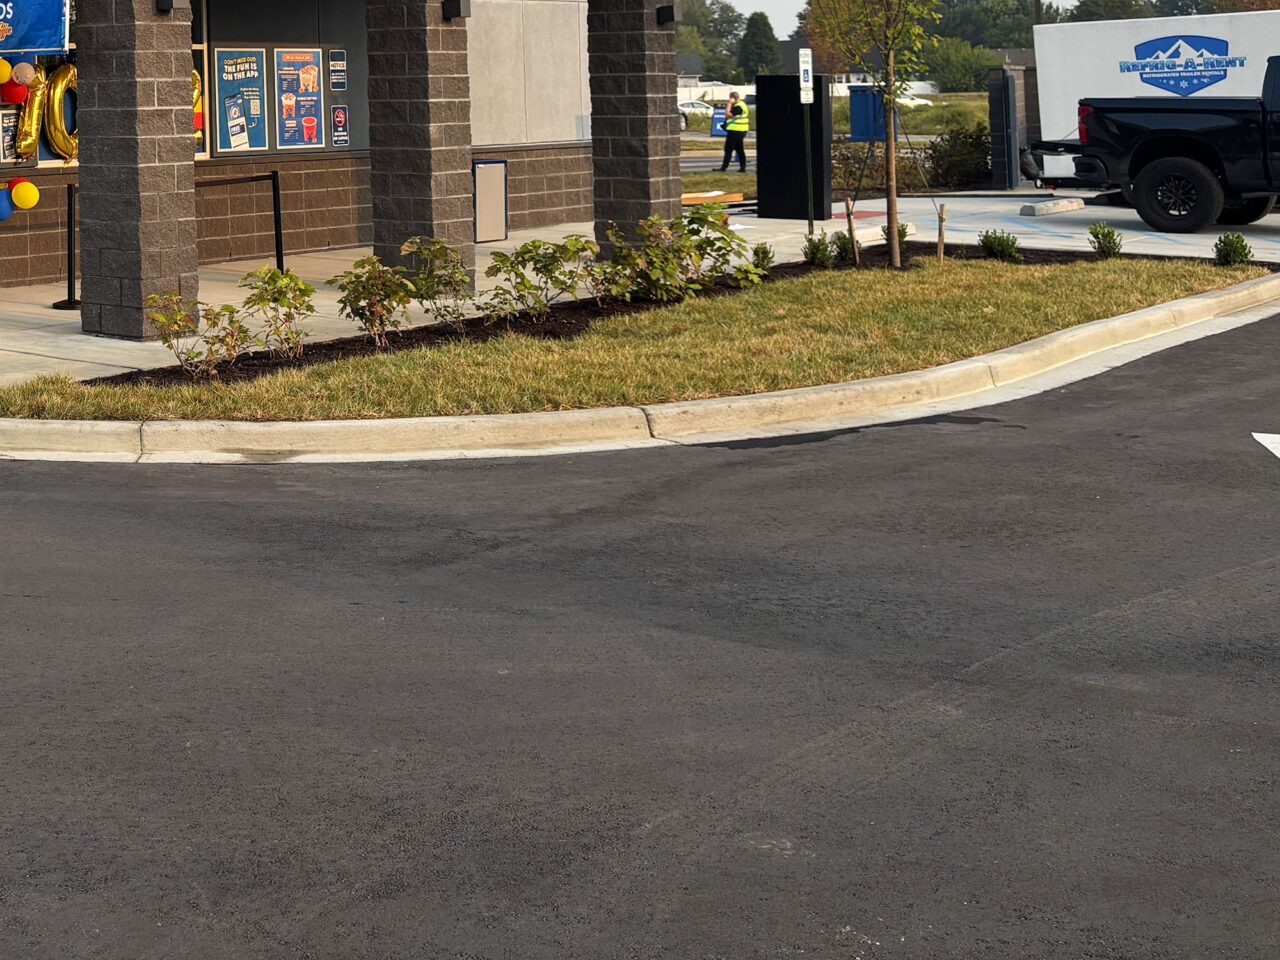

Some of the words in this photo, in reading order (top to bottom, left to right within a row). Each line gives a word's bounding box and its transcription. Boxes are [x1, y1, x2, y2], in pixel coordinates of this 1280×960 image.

[224, 65, 236, 73] THE
[237, 63, 250, 72] FUN
[251, 62, 257, 71] IS
[1119, 56, 1247, 72] REFRIG-A-RENT
[222, 73, 233, 81] ON
[234, 71, 246, 80] THE
[246, 70, 259, 79] APP
